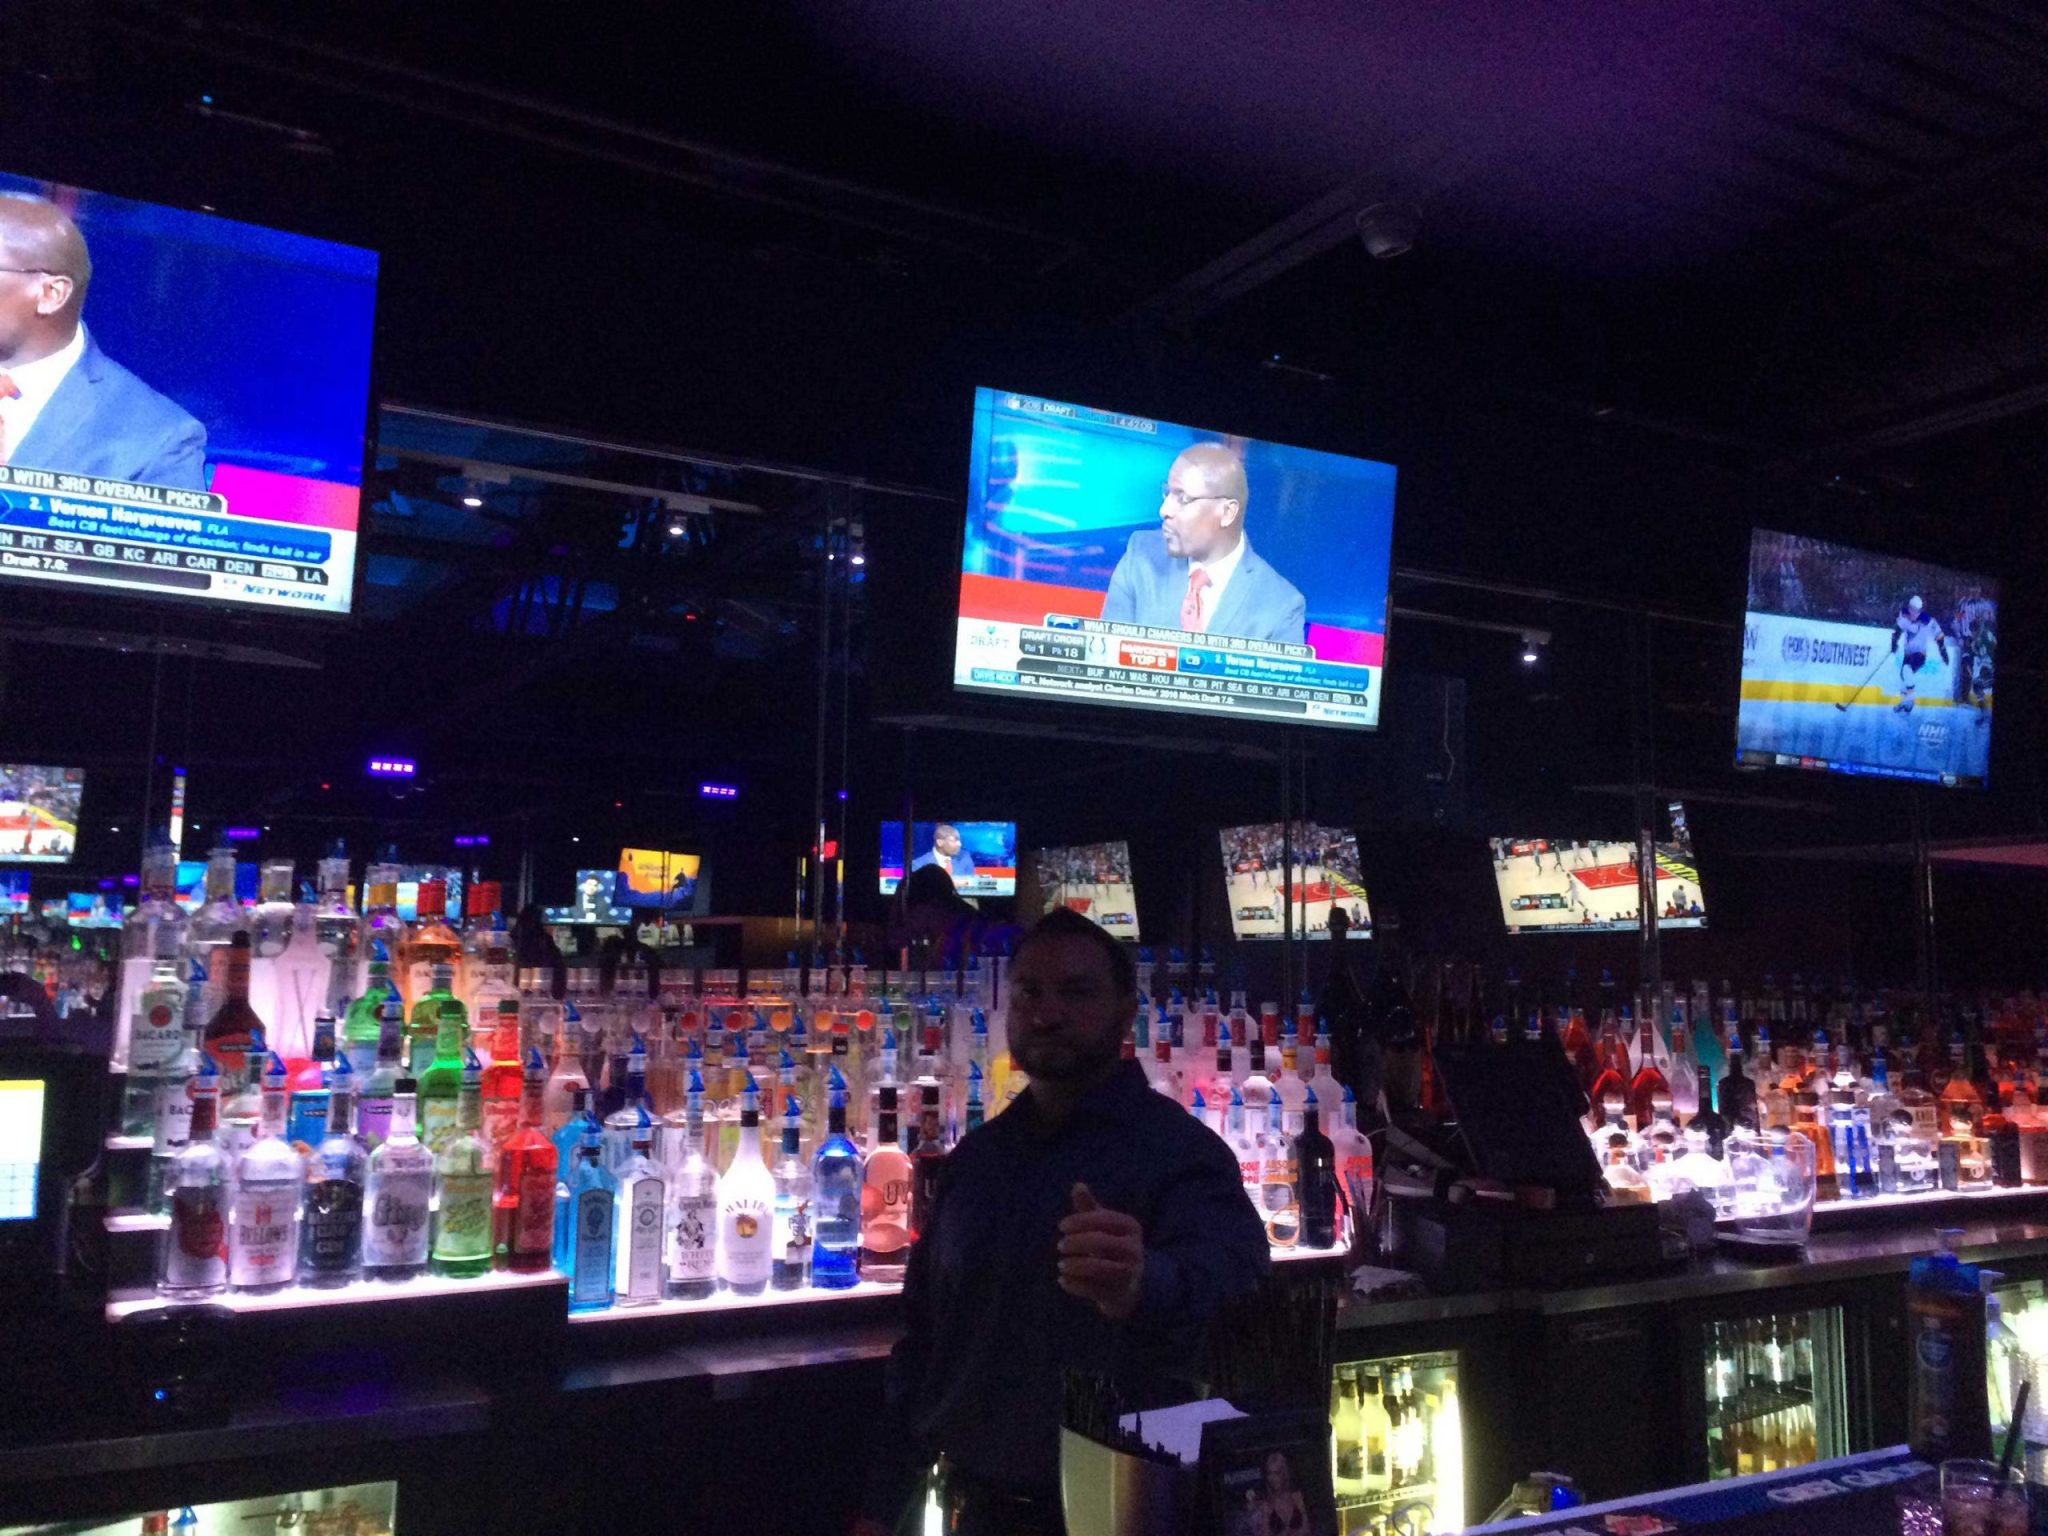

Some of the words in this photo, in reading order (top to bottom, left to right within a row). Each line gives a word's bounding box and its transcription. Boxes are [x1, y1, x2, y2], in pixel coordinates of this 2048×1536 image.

[13, 469, 55, 488] WITH
[58, 476, 91, 493] 3RD
[94, 481, 163, 503] OVERALL
[166, 490, 210, 510] PICK?
[29, 496, 44, 512] 2.
[50, 498, 108, 520] Vernon
[111, 506, 202, 532] Hargreaves
[207, 523, 229, 535] FLA
[48, 515, 77, 529] Best
[79, 520, 98, 532] CB
[173, 533, 186, 543] of
[272, 545, 293, 556] ball
[293, 547, 304, 558] in
[306, 551, 322, 560] air
[2, 553, 40, 568] Draft
[22, 535, 47, 548] PIT
[54, 539, 85, 554] SEA
[93, 543, 116, 557] GB
[123, 547, 146, 561] KC
[152, 552, 178, 565] ARI
[185, 555, 218, 570] CAR
[224, 560, 255, 574] DEN
[303, 570, 321, 582] LA
[243, 583, 327, 602] NETWORK
[1022, 630, 1051, 642] DRAFT
[1054, 633, 1084, 645] ORDER
[1024, 644, 1036, 653] Rd
[1038, 645, 1044, 654] 1
[1052, 647, 1062, 655] Pk
[1064, 648, 1079, 658] 18
[1084, 620, 1110, 634] WHAT
[1112, 623, 1145, 636] SHOULD
[1148, 627, 1192, 642] CHARGERS
[1194, 634, 1206, 644] DO
[1207, 635, 1228, 647] WITH
[1229, 638, 1246, 649] 3RD
[1248, 640, 1283, 654] OVERALL
[1284, 644, 1307, 657] PICK?
[1129, 654, 1156, 666] TOP
[1185, 655, 1200, 665] CB
[1810, 639, 1872, 666] SOUTHWEST
[1021, 674, 1037, 684] NFL
[1039, 677, 1074, 689] Network
[1075, 681, 1104, 693] analyst
[1104, 684, 1134, 695] Charles
[1160, 689, 1178, 699] 2016
[1201, 694, 1220, 703] Draft
[1087, 667, 1104, 677] BUF
[1109, 670, 1126, 680] NYJ
[1129, 672, 1148, 682] WAS
[1152, 675, 1170, 684] HOU
[1173, 677, 1189, 687] MIN
[1193, 679, 1207, 689] CIN
[1211, 681, 1224, 691] PIT
[1227, 682, 1243, 693] SEA
[1247, 685, 1258, 694] GB
[1262, 686, 1273, 695] KC
[1277, 687, 1290, 697] ARI
[1293, 690, 1310, 700] CAR
[1314, 692, 1329, 701] DEN
[1354, 696, 1364, 705] LA
